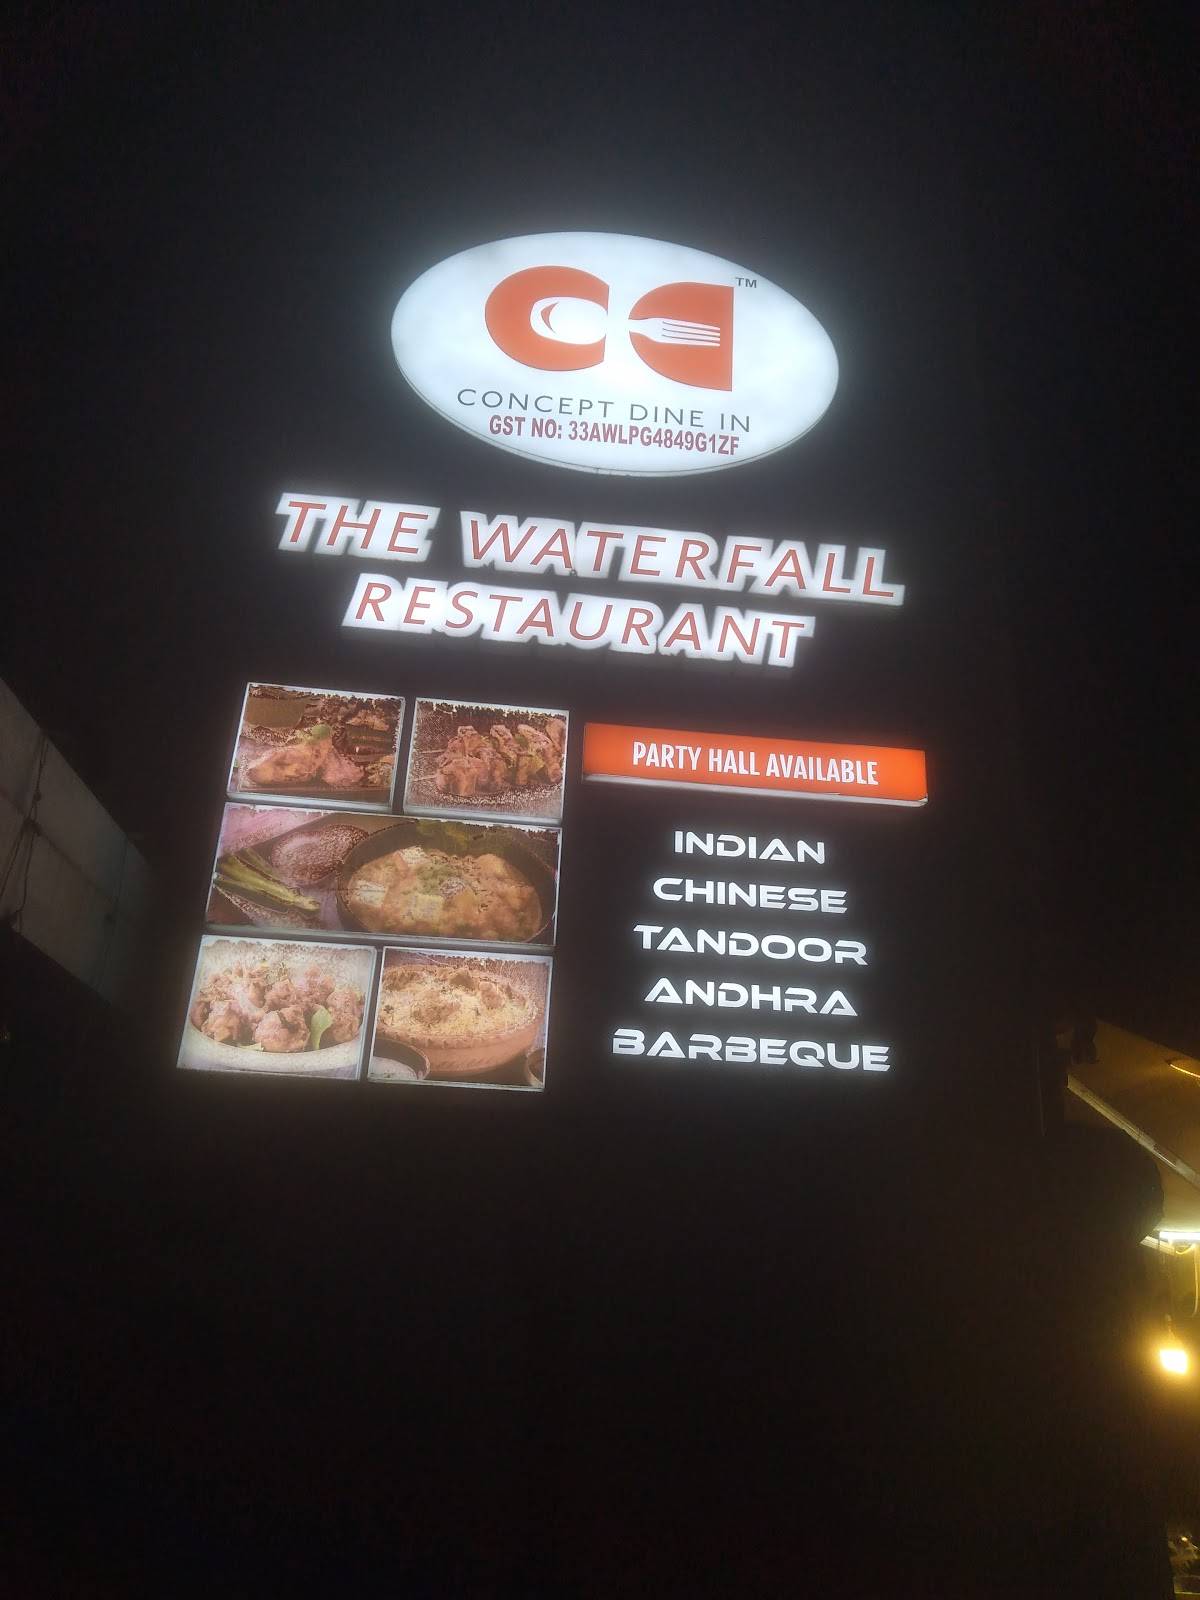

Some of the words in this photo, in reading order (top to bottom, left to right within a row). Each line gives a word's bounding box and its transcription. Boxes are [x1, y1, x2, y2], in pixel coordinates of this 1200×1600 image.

[457, 388, 614, 418] CONCEPT
[630, 404, 704, 428] DINE
[720, 413, 750, 433] IN
[489, 415, 525, 436] GST
[531, 417, 562, 439] NO:
[568, 420, 739, 455] 33AWLPG4849G1ZF
[288, 500, 429, 554] THE
[469, 520, 894, 598] WATERFALL
[356, 582, 805, 659] RESTAURANT
[632, 741, 702, 770] PARTY
[708, 748, 760, 776] HALL
[766, 753, 879, 785] AVAILABLE
[674, 830, 825, 864] INDIAN
[653, 877, 848, 914] CHINESE
[633, 924, 868, 966] TANDOOR
[644, 977, 858, 1017] ANDHRA
[612, 1028, 891, 1072] BARBEQUE
